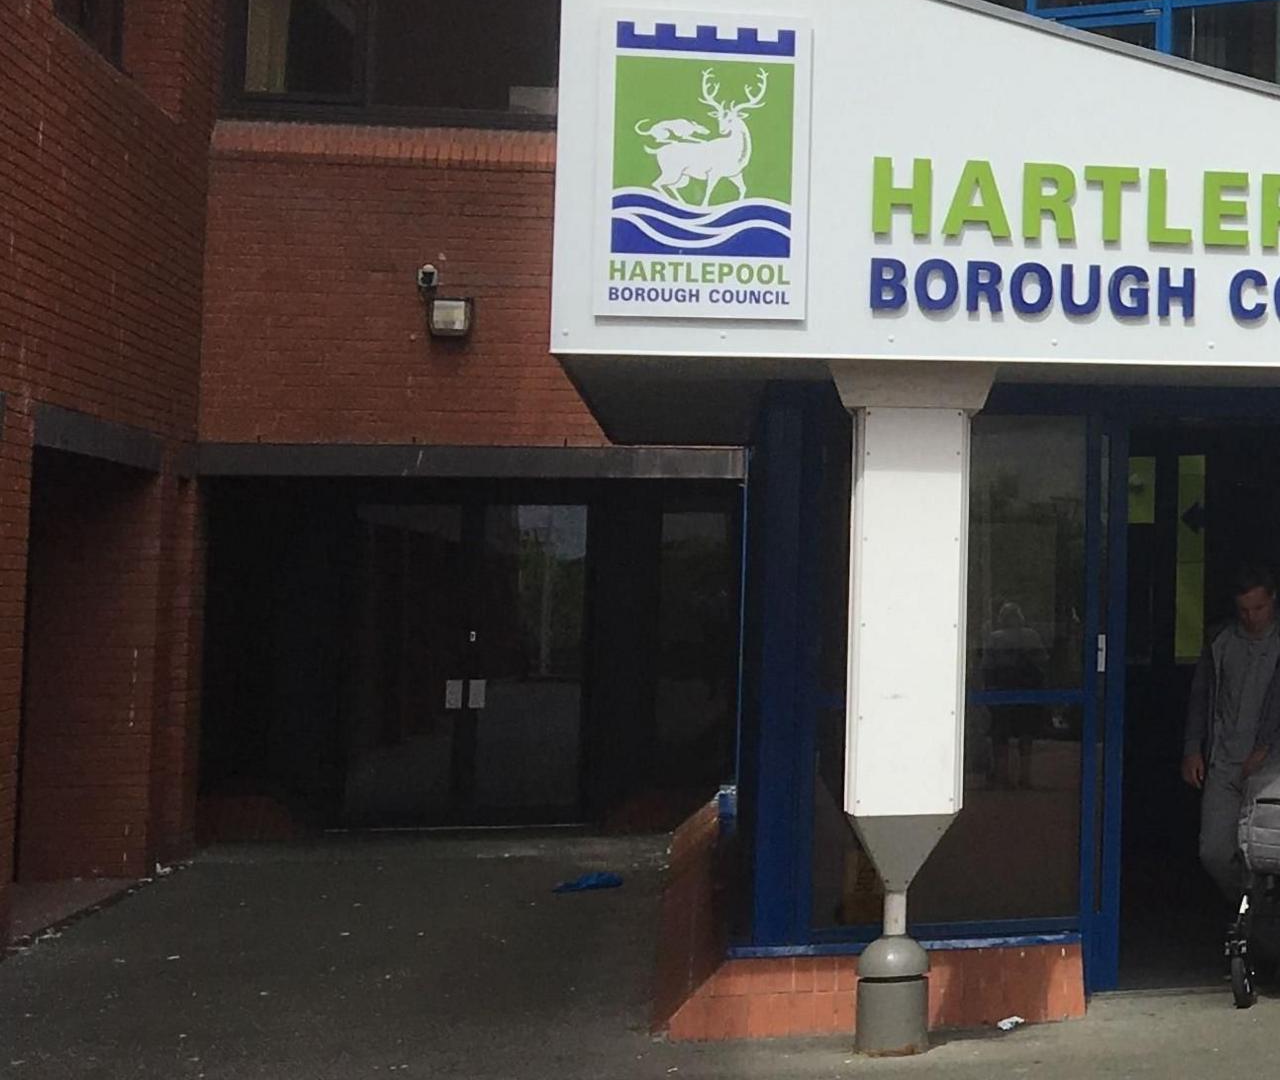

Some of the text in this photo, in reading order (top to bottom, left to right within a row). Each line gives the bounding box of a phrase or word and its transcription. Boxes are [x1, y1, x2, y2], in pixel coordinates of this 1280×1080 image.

[608, 260, 790, 285] HARTLEPOOL
[608, 287, 790, 306] BOROUGH COUNCIL
[869, 258, 1195, 318] BOROUGH
